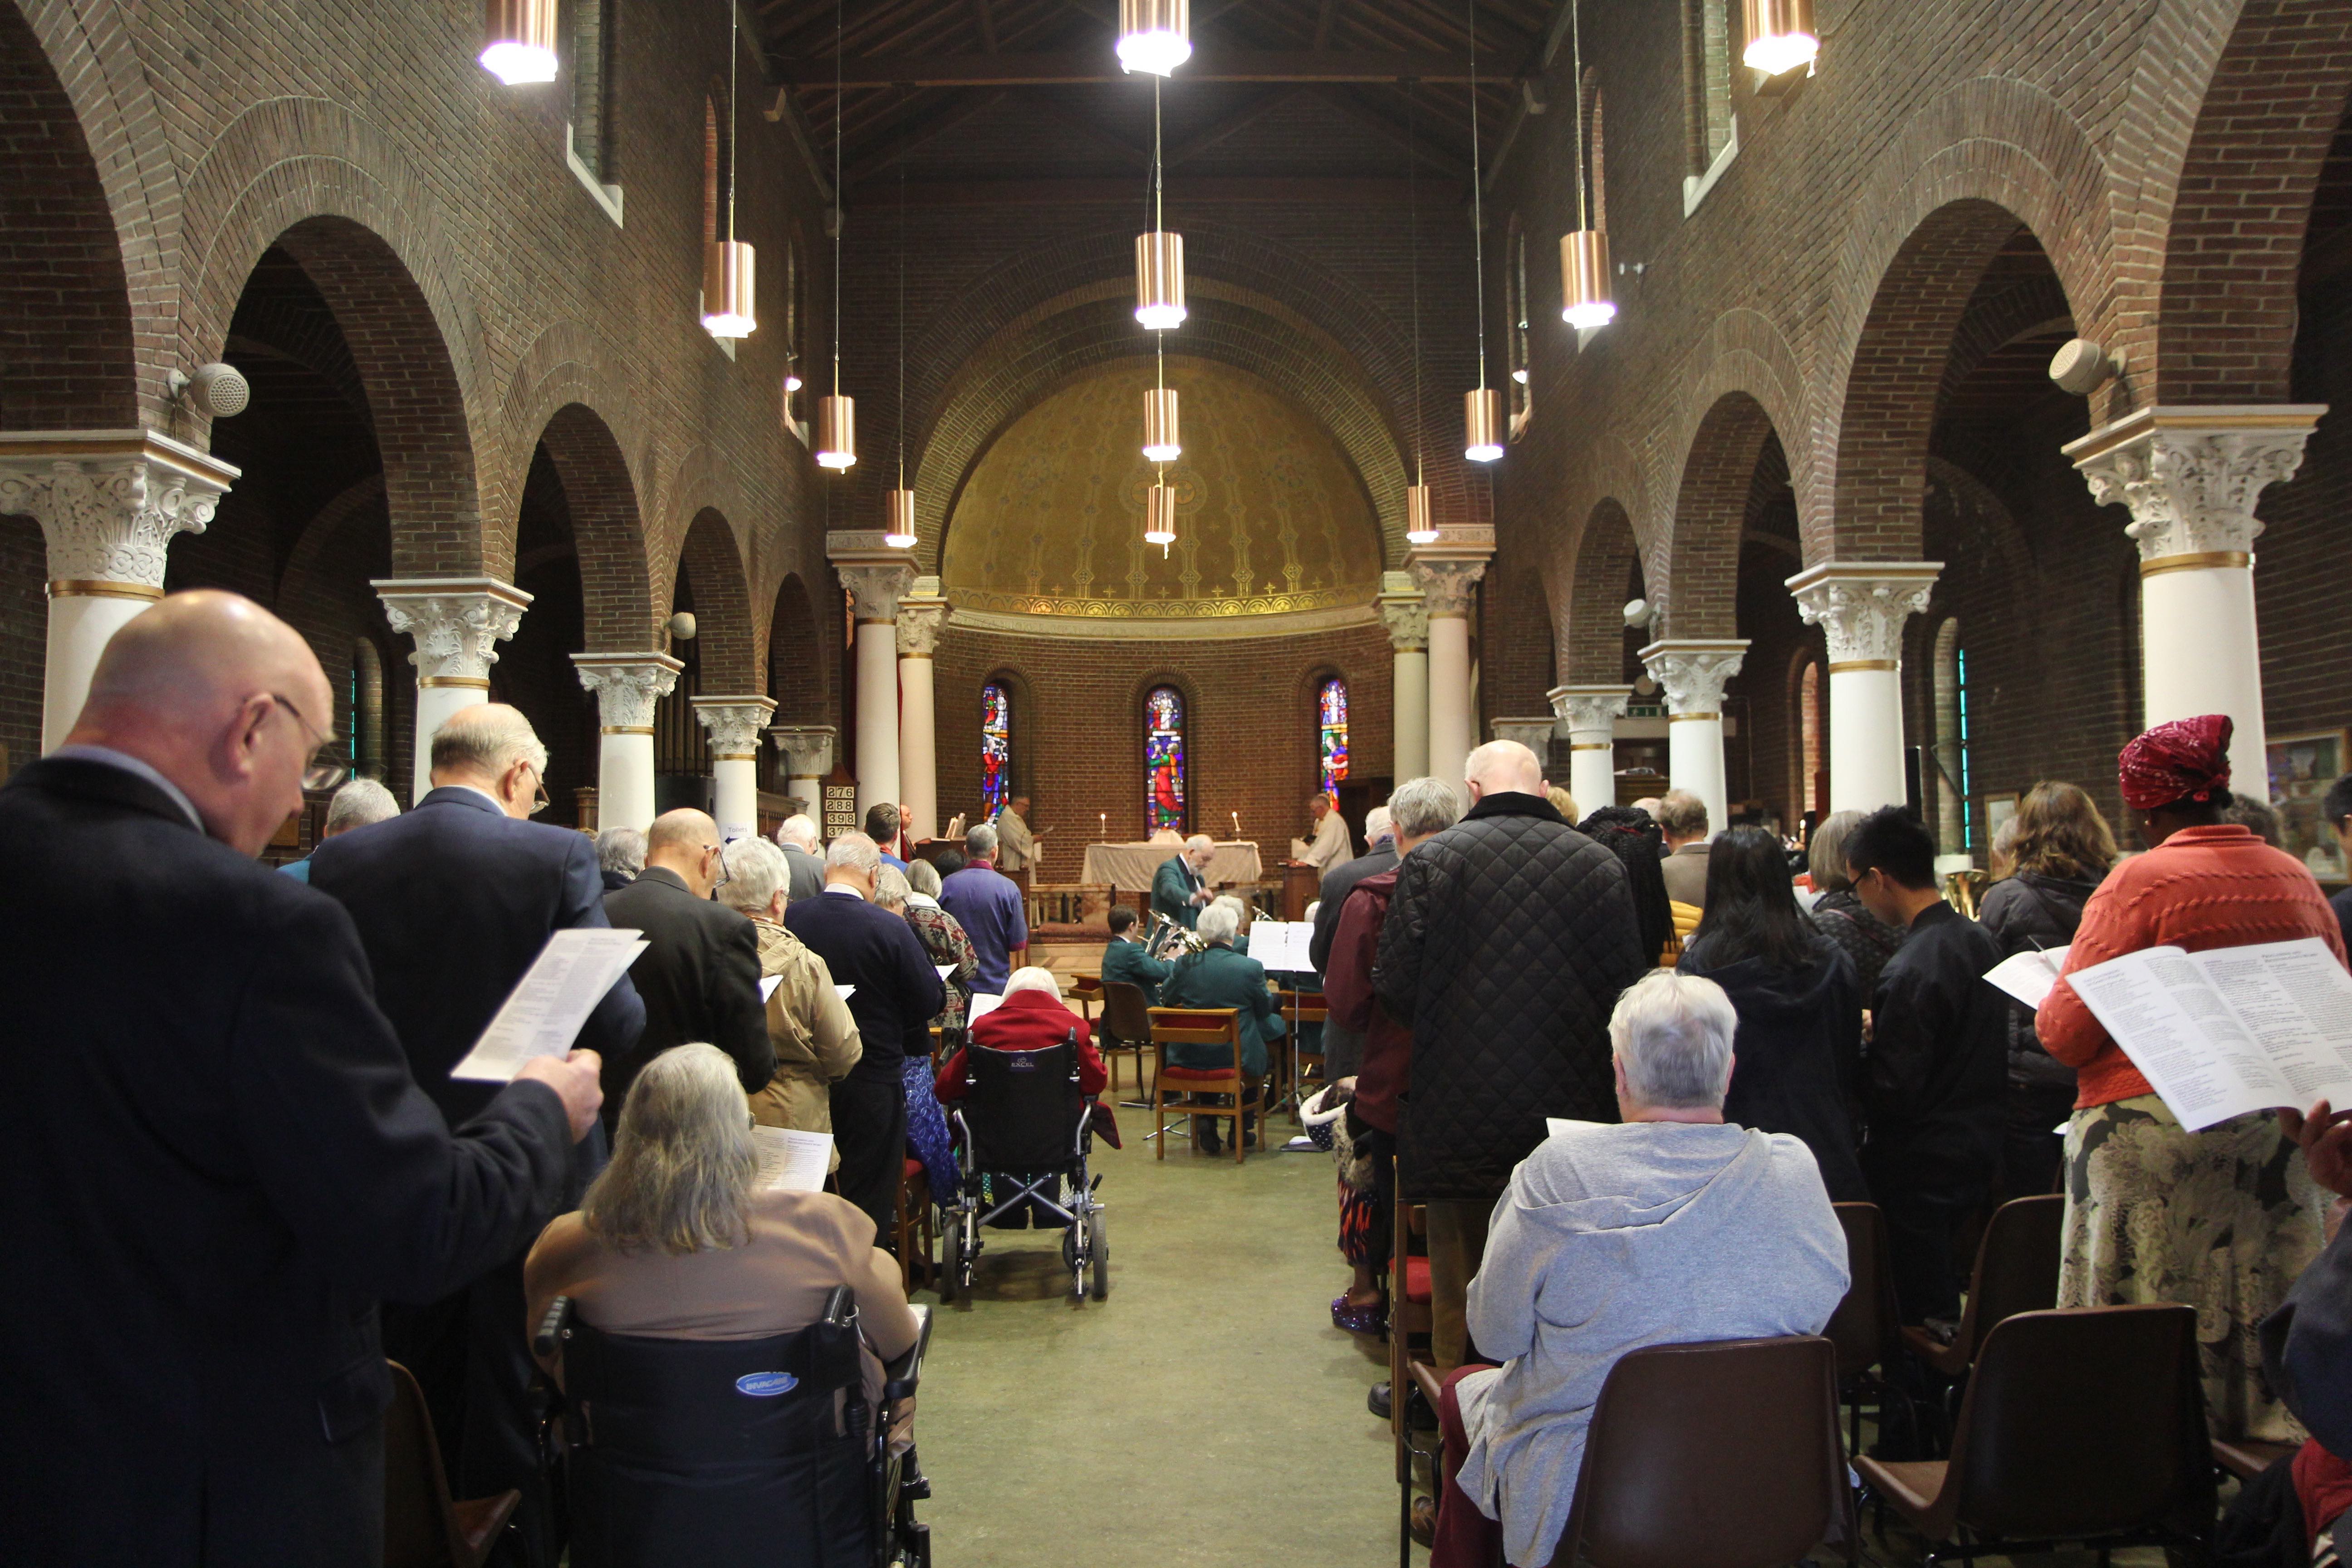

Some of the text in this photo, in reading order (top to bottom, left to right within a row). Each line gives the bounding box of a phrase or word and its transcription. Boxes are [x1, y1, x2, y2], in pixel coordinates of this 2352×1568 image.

[828, 788, 853, 797] 276
[827, 801, 852, 810] 288
[829, 814, 853, 823] 398
